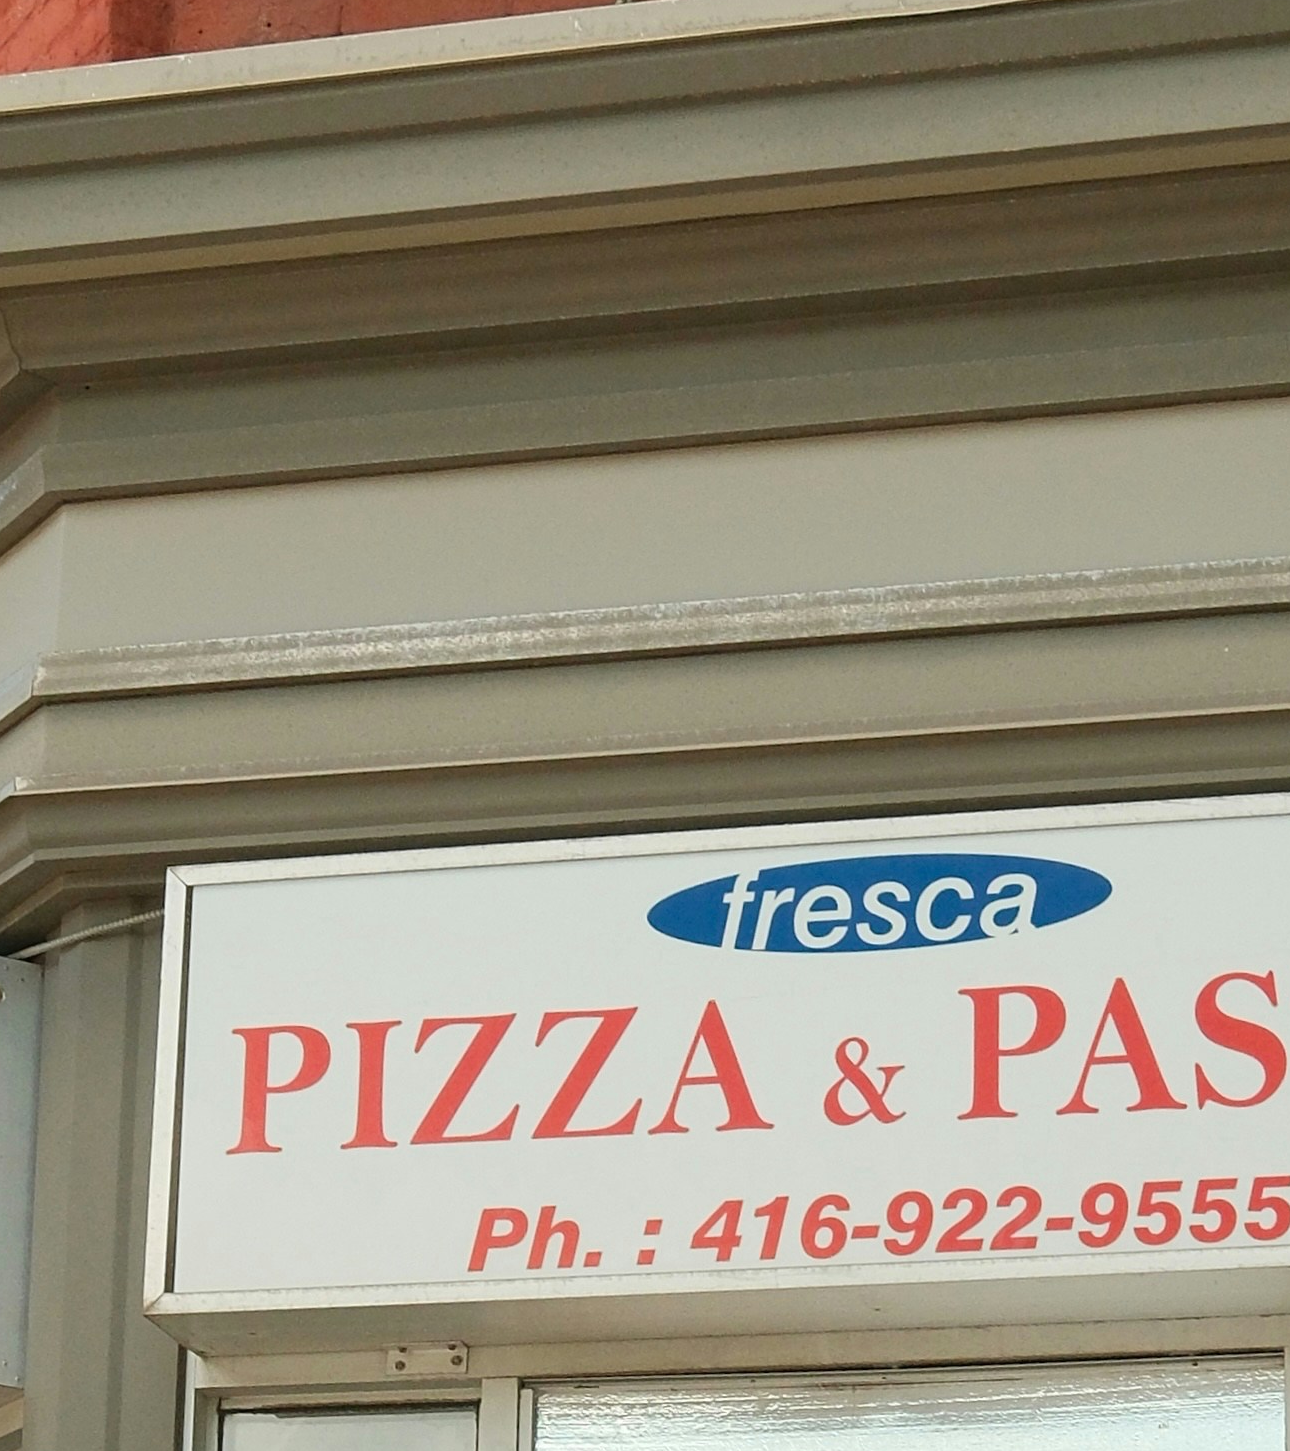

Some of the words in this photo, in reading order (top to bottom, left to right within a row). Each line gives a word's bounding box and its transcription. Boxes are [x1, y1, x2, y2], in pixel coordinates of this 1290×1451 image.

[719, 865, 1042, 953] fresca
[226, 999, 775, 1154] PIZZA
[822, 1036, 906, 1126] &
